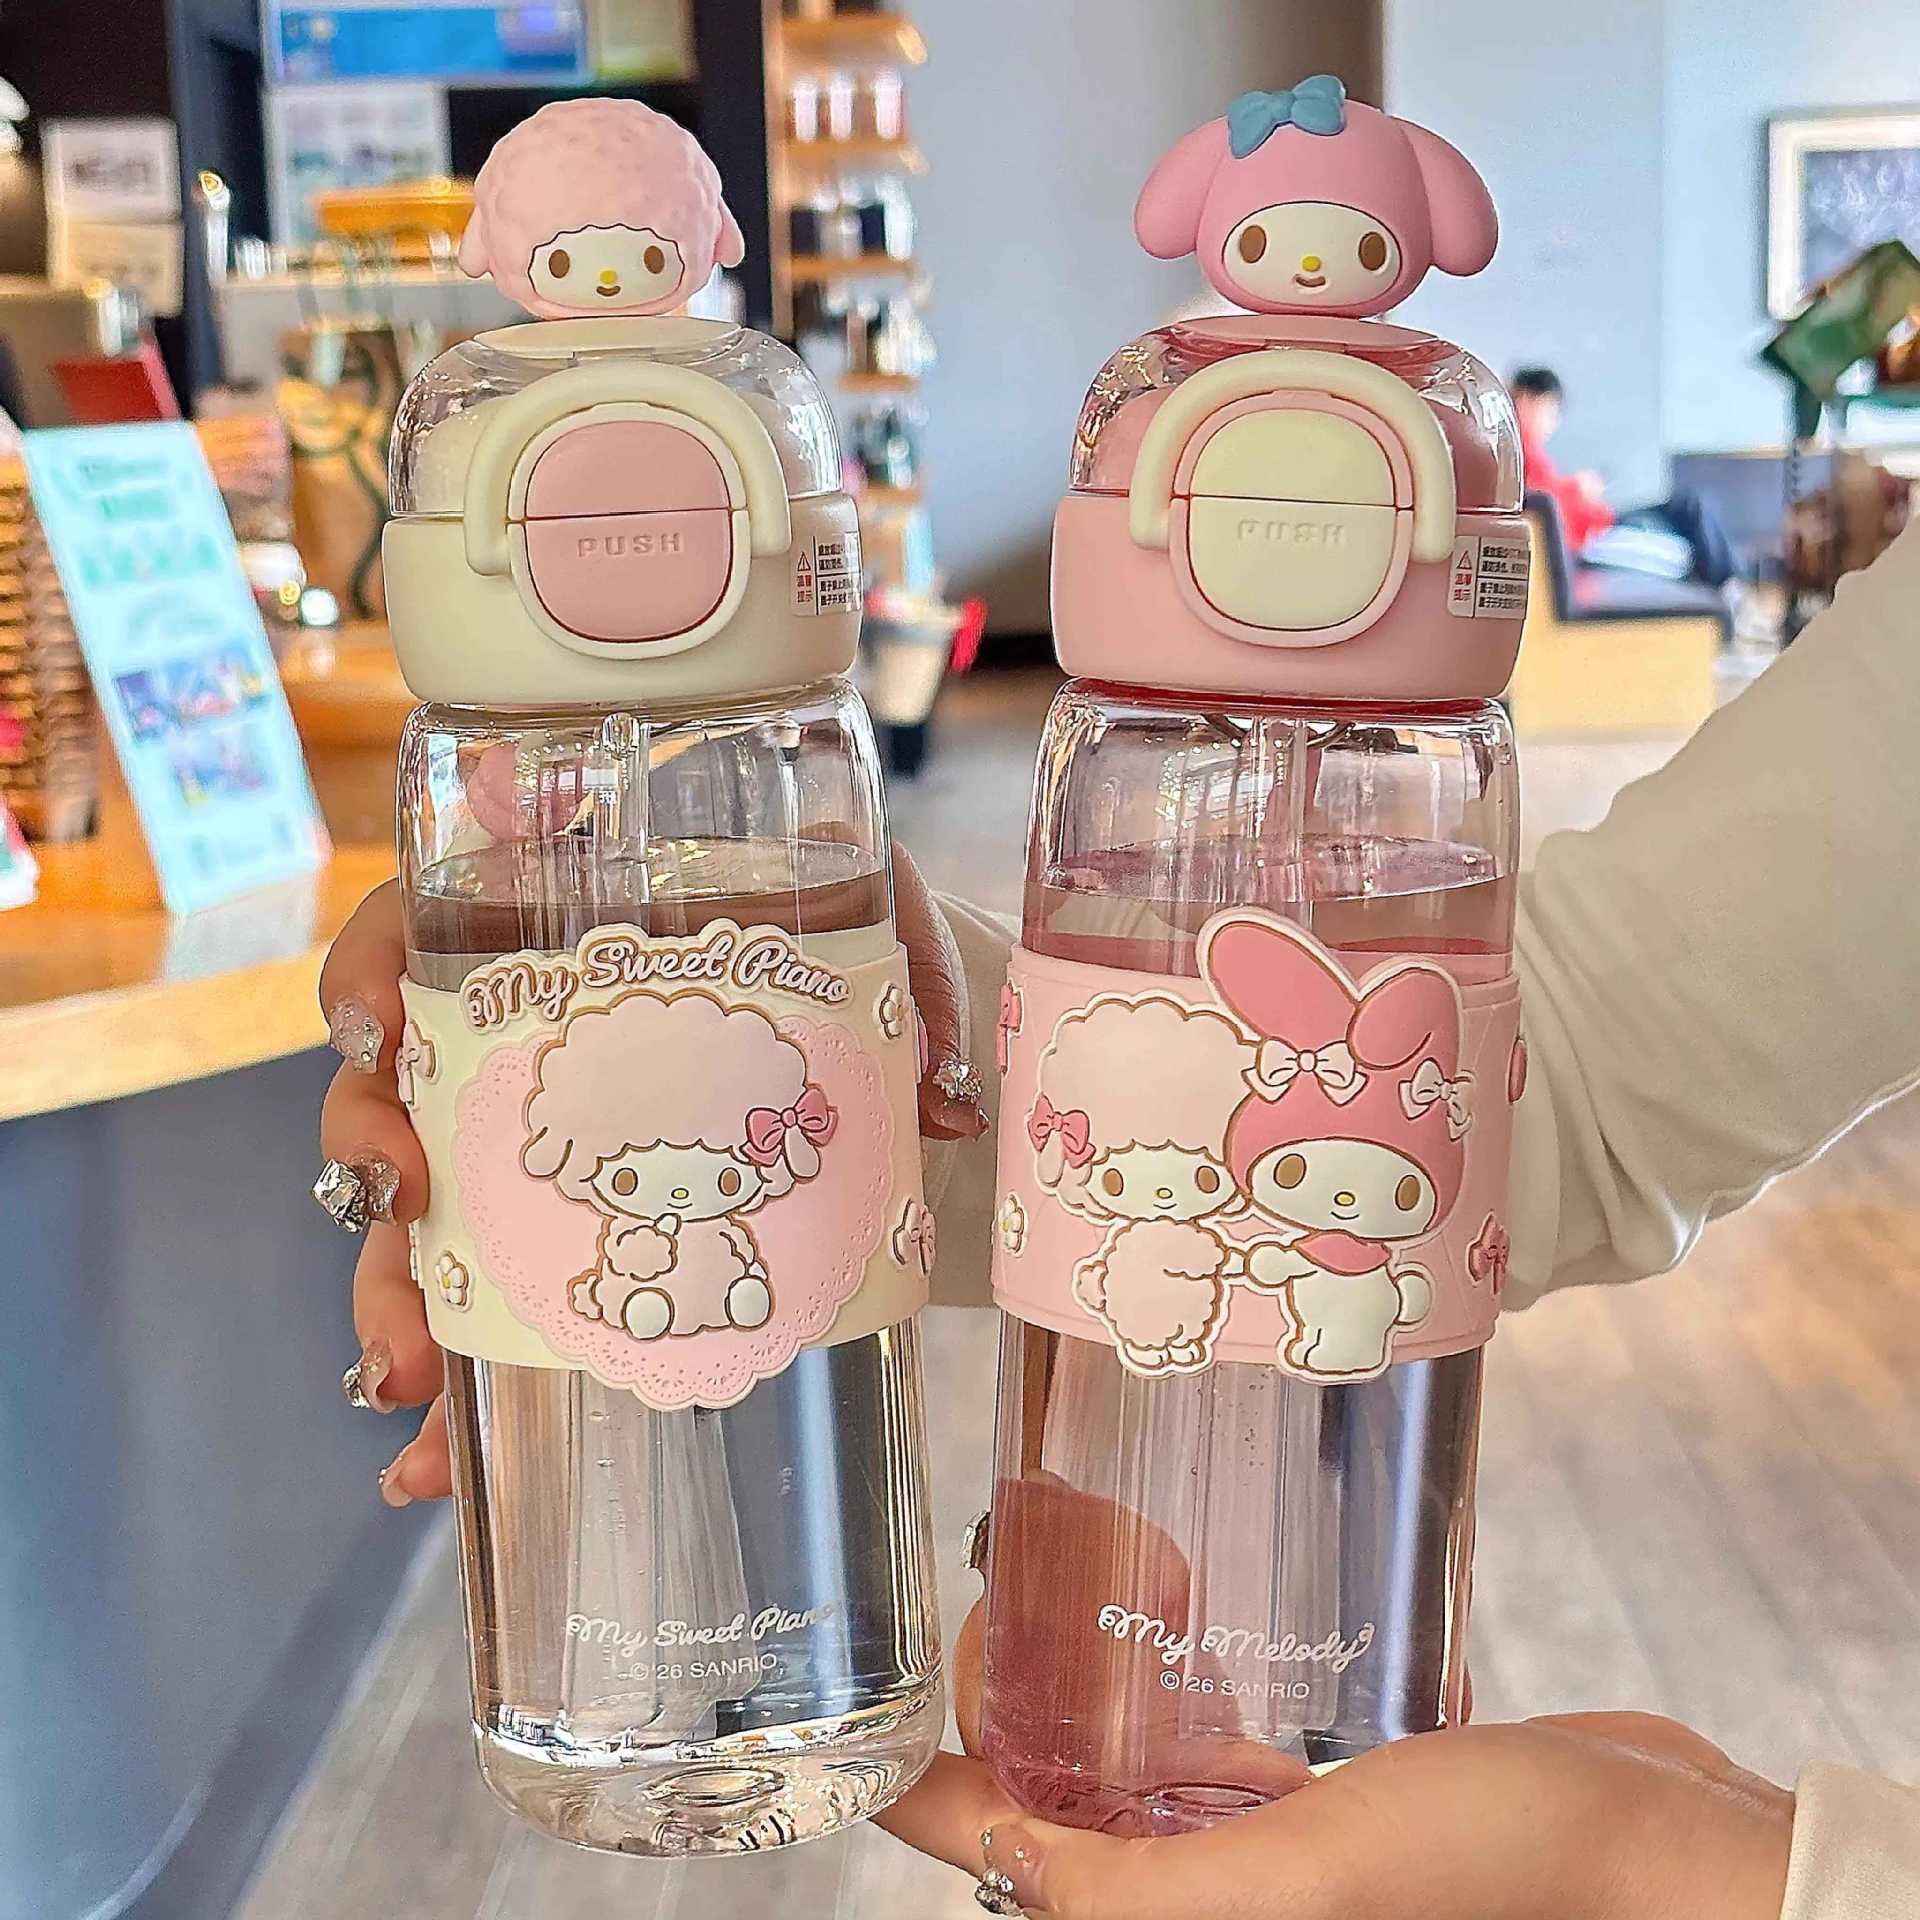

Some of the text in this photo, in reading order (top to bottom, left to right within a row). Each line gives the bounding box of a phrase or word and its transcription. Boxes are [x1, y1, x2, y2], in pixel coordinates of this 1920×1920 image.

[577, 532, 681, 558] PUSH
[1237, 518, 1346, 545] PUSH
[465, 929, 851, 1027] My Sweet Piano
[566, 1613, 648, 1657] My
[654, 1613, 743, 1647] Sweet
[1097, 1603, 1376, 1673] My Melody
[1220, 1679, 1310, 1699] SANRIO
